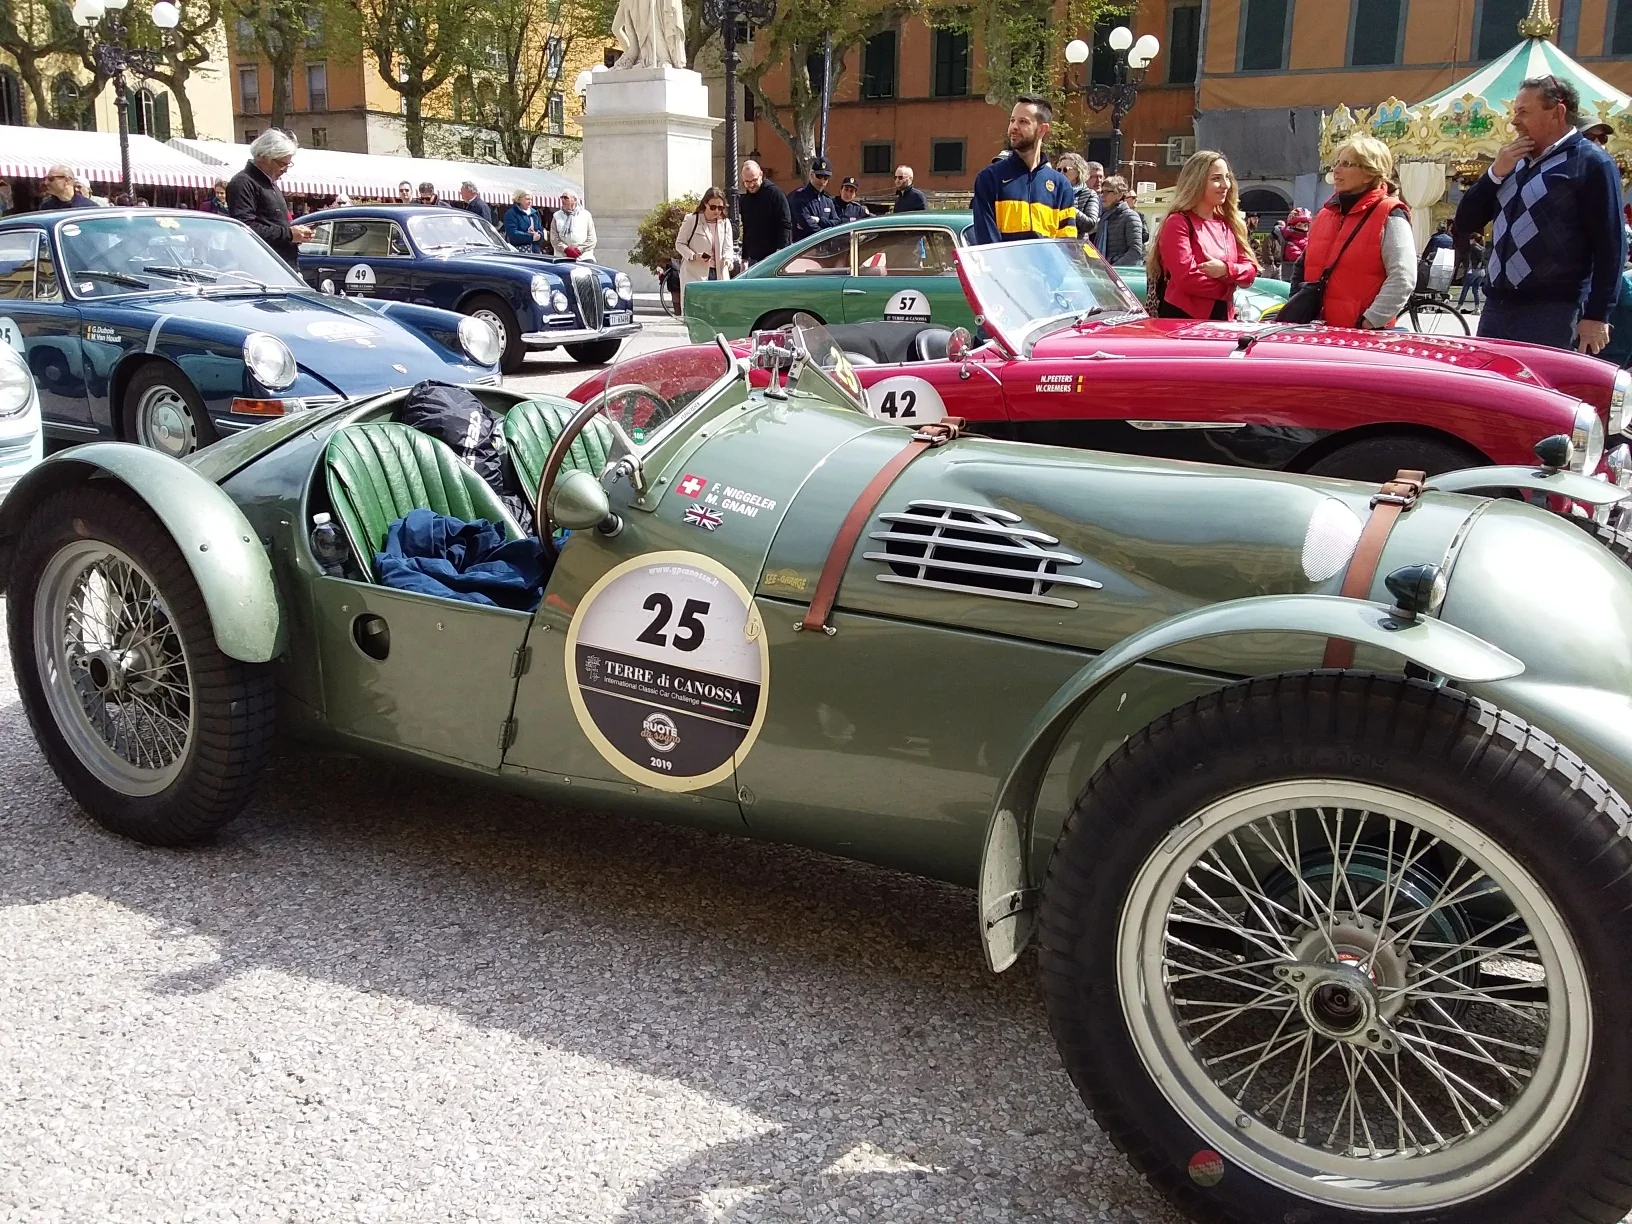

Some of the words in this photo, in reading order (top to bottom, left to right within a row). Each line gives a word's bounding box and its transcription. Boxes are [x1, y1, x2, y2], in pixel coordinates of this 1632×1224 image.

[354, 269, 367, 281] 49
[899, 296, 917, 311] 57
[1035, 384, 1072, 393] W.CREMERS
[1040, 374, 1073, 383] N.PEETERS
[880, 390, 917, 419] 42
[704, 492, 719, 506] M.
[721, 498, 760, 518] GNANI
[711, 482, 722, 493] F.
[722, 485, 777, 510] NIGGELER
[648, 566, 720, 588] www.gpcanossa.it
[635, 592, 711, 652] 25
[603, 676, 638, 690] International
[638, 684, 659, 695] Classic
[659, 689, 671, 698] Car
[671, 692, 700, 706] Challenge
[604, 660, 654, 684] TERRE
[656, 673, 671, 688] di
[673, 676, 743, 706] CANOSSA
[643, 720, 678, 738] RUOTE
[650, 756, 673, 771] 2019
